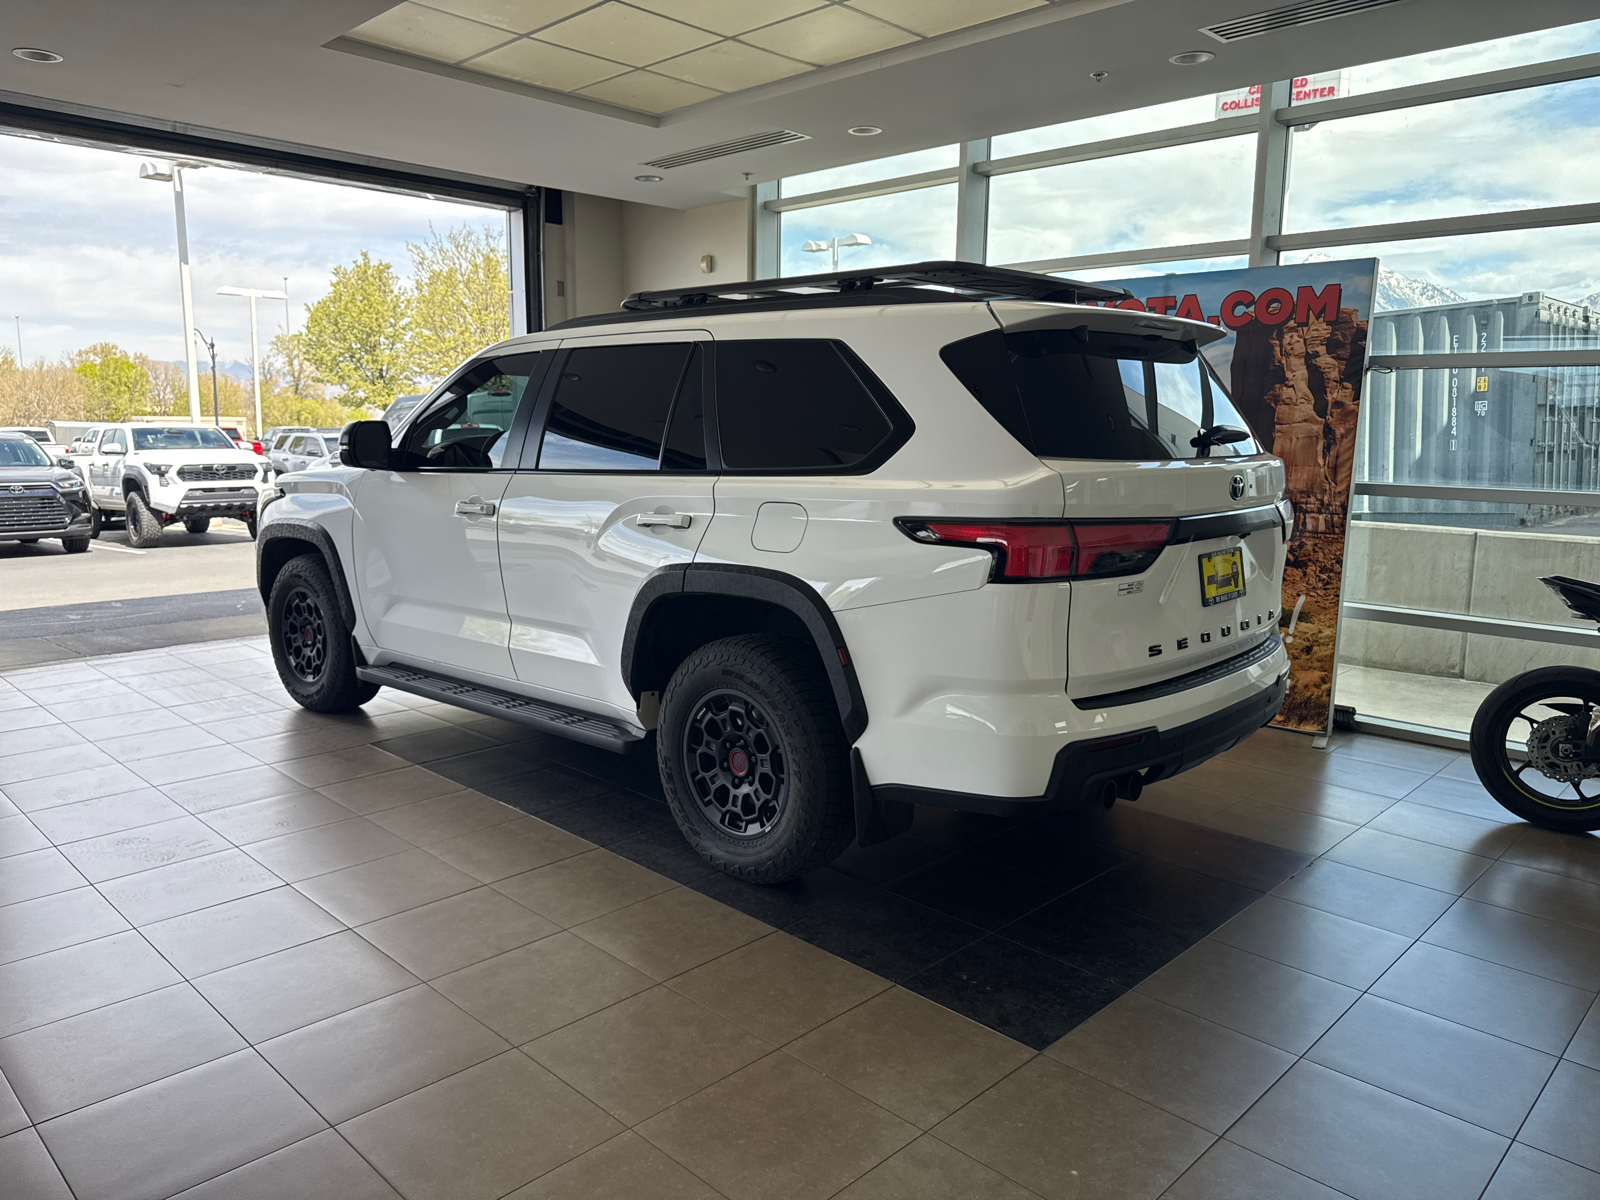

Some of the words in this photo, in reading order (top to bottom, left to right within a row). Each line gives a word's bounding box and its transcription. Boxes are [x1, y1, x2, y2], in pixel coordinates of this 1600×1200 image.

[1221, 96, 1260, 112] COLLIS
[1293, 85, 1335, 102] ENTER
[1148, 608, 1275, 657] SEQUOIA
[721, 667, 794, 739] WILDPEAK
